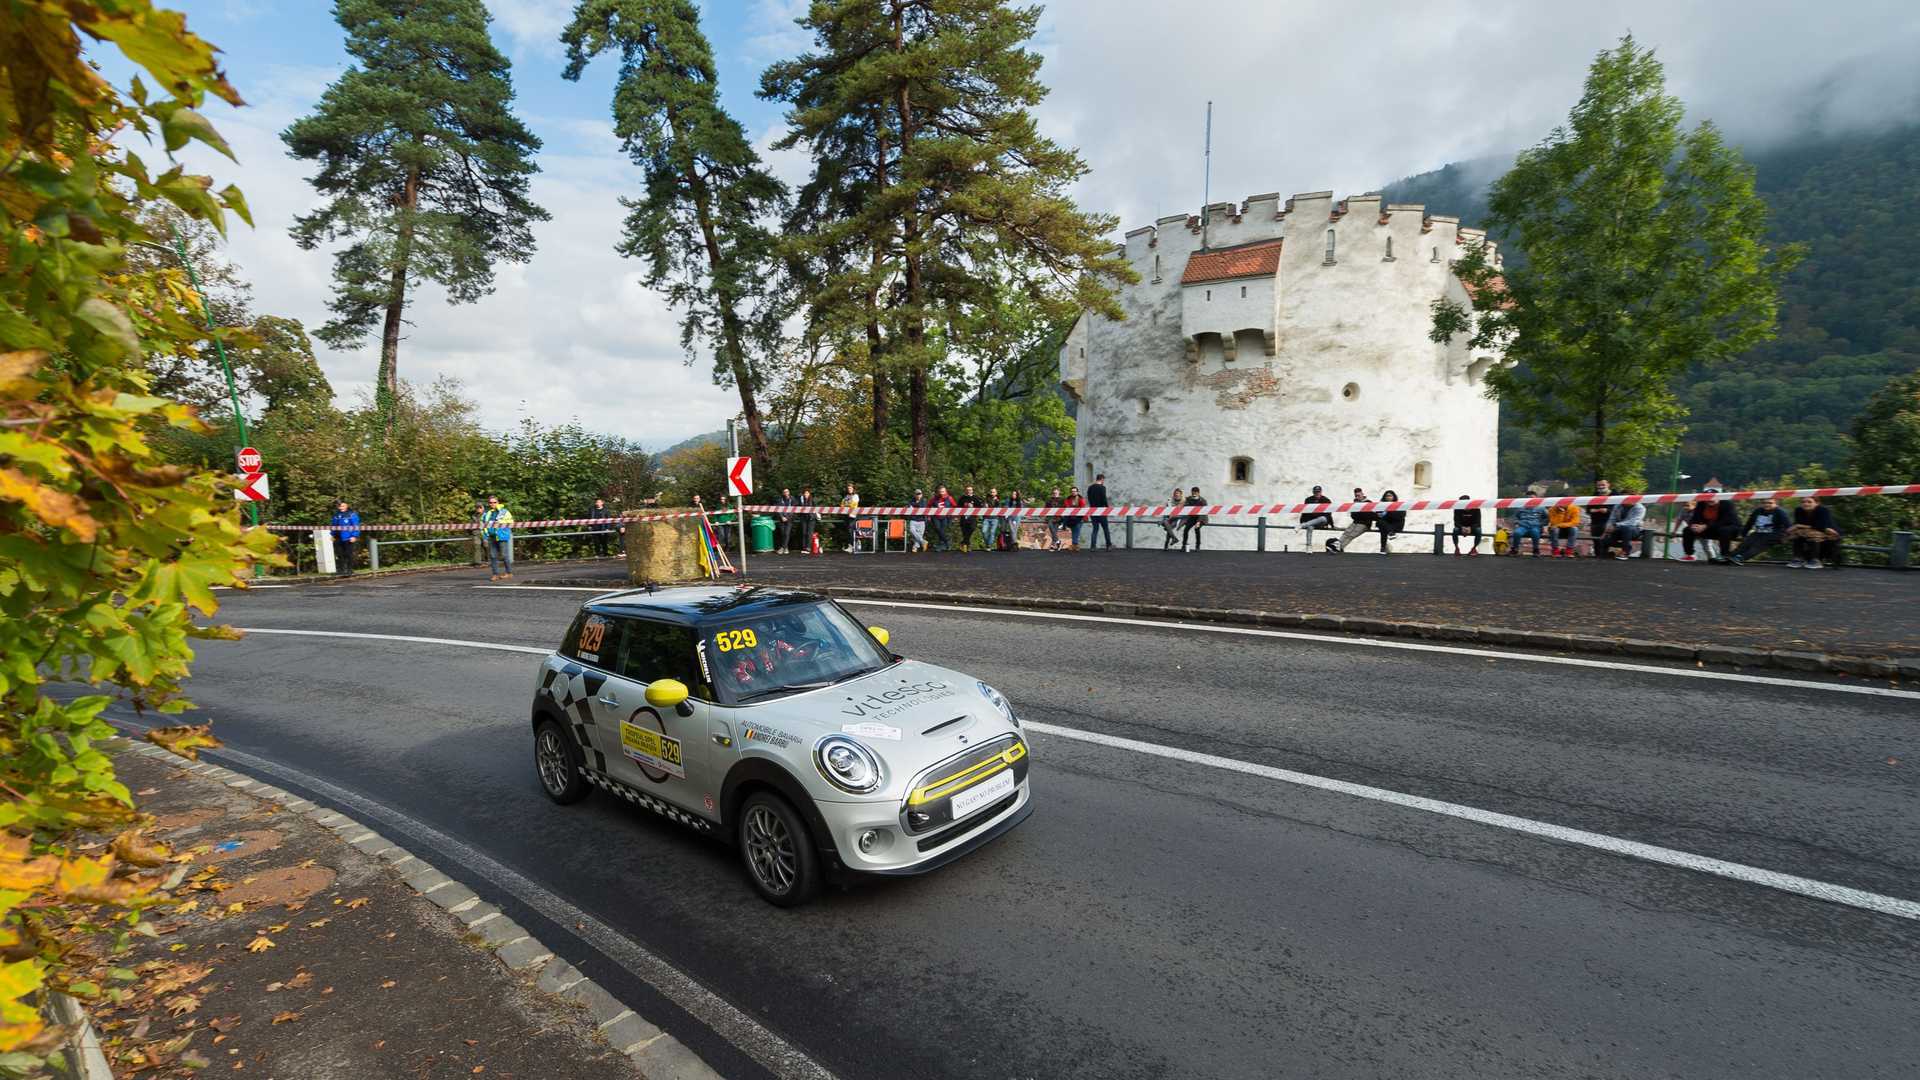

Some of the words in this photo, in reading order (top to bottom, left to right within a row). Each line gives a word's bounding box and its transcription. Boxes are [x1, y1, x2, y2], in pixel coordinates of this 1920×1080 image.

[239, 454, 261, 467] STOP
[580, 619, 605, 652] 529
[716, 628, 758, 652] 529
[700, 651, 711, 683] MICHELIN
[841, 680, 947, 717] vitesco
[872, 690, 956, 721] TECHNOLOGIES
[742, 719, 777, 735] AUTOMOBILE
[777, 729, 804, 745] BAVARIA
[662, 739, 680, 764] 529
